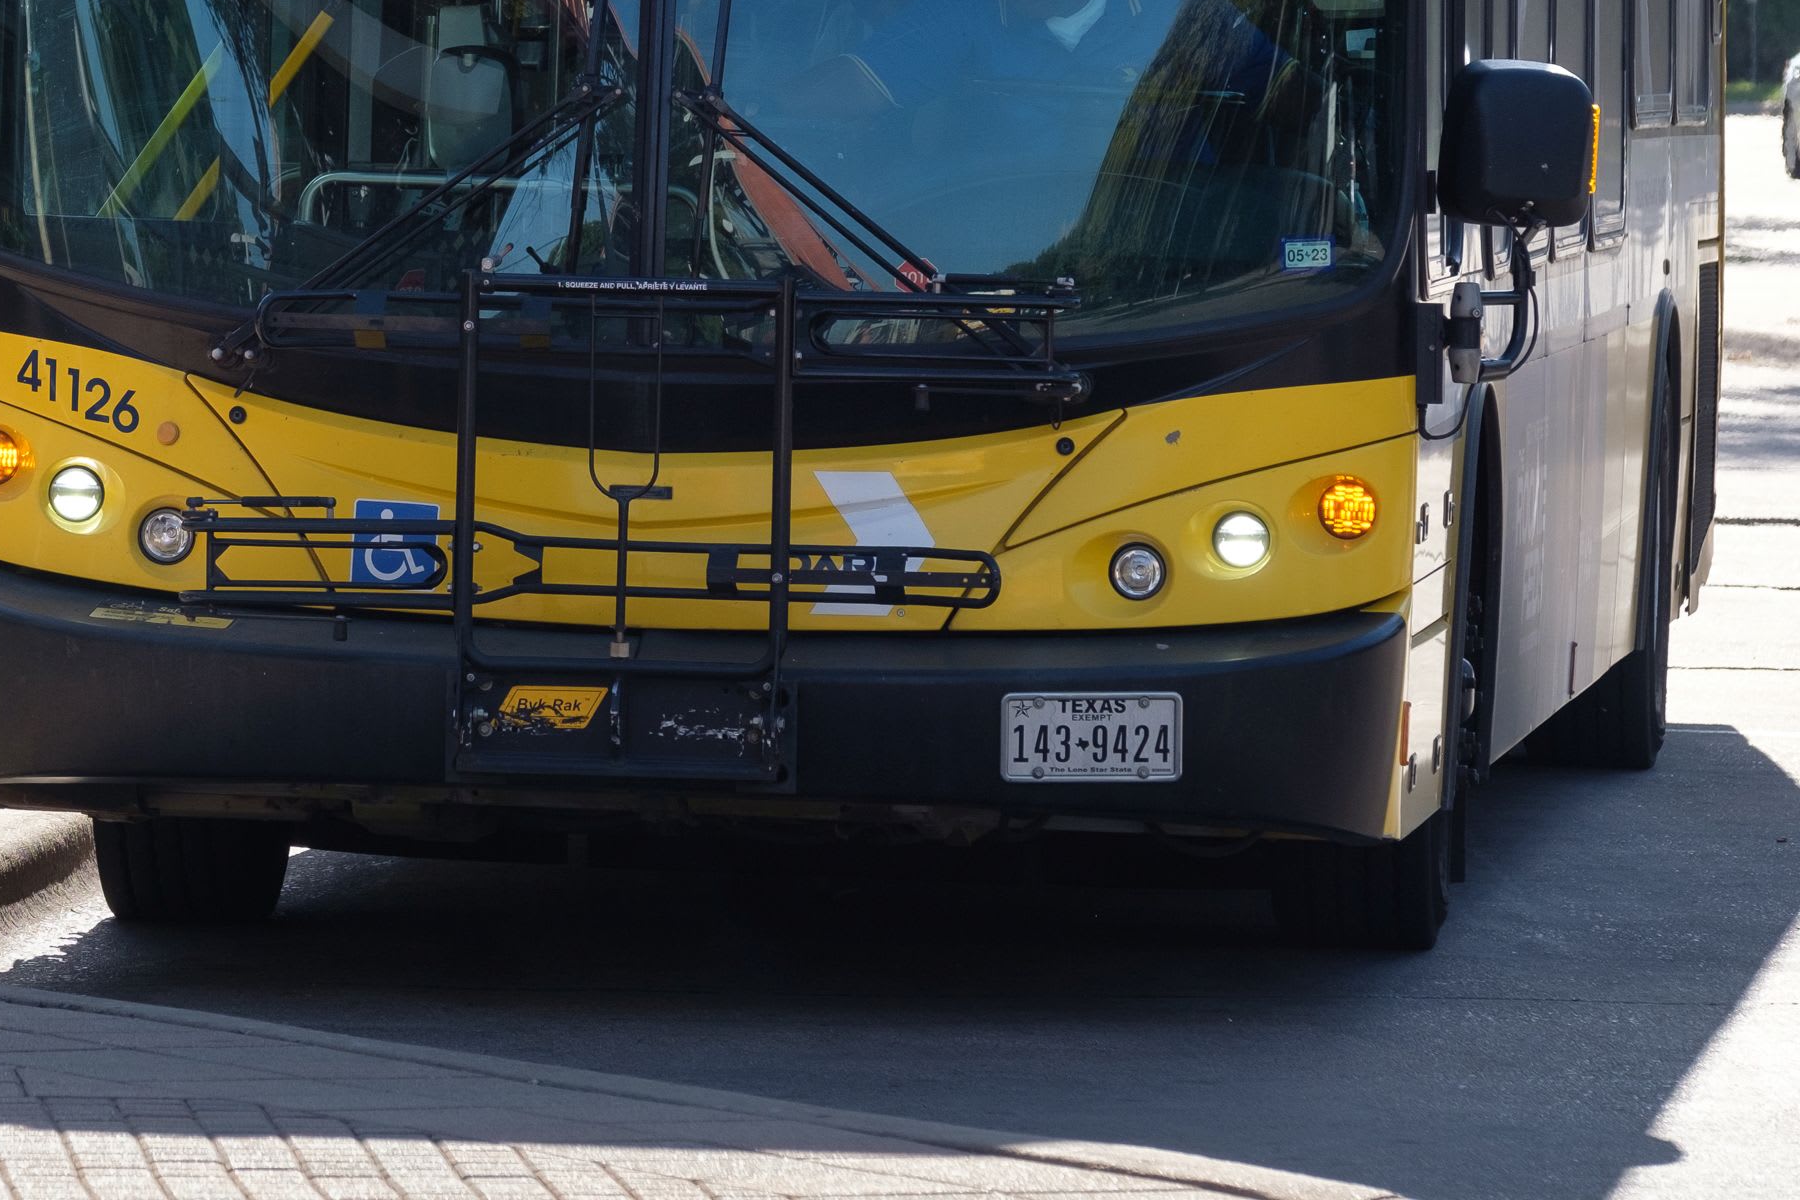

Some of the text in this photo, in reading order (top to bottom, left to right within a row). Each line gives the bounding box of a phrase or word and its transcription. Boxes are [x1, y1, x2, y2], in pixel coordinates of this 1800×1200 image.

[1287, 248, 1329, 263] 05 23
[565, 281, 599, 289] SQUEEZE
[676, 281, 708, 291] LEVANTE
[16, 349, 140, 434] 41126
[1056, 699, 1127, 714] TEXAS
[1071, 714, 1113, 722] EXEMPT
[1012, 724, 1171, 763] 143 9424
